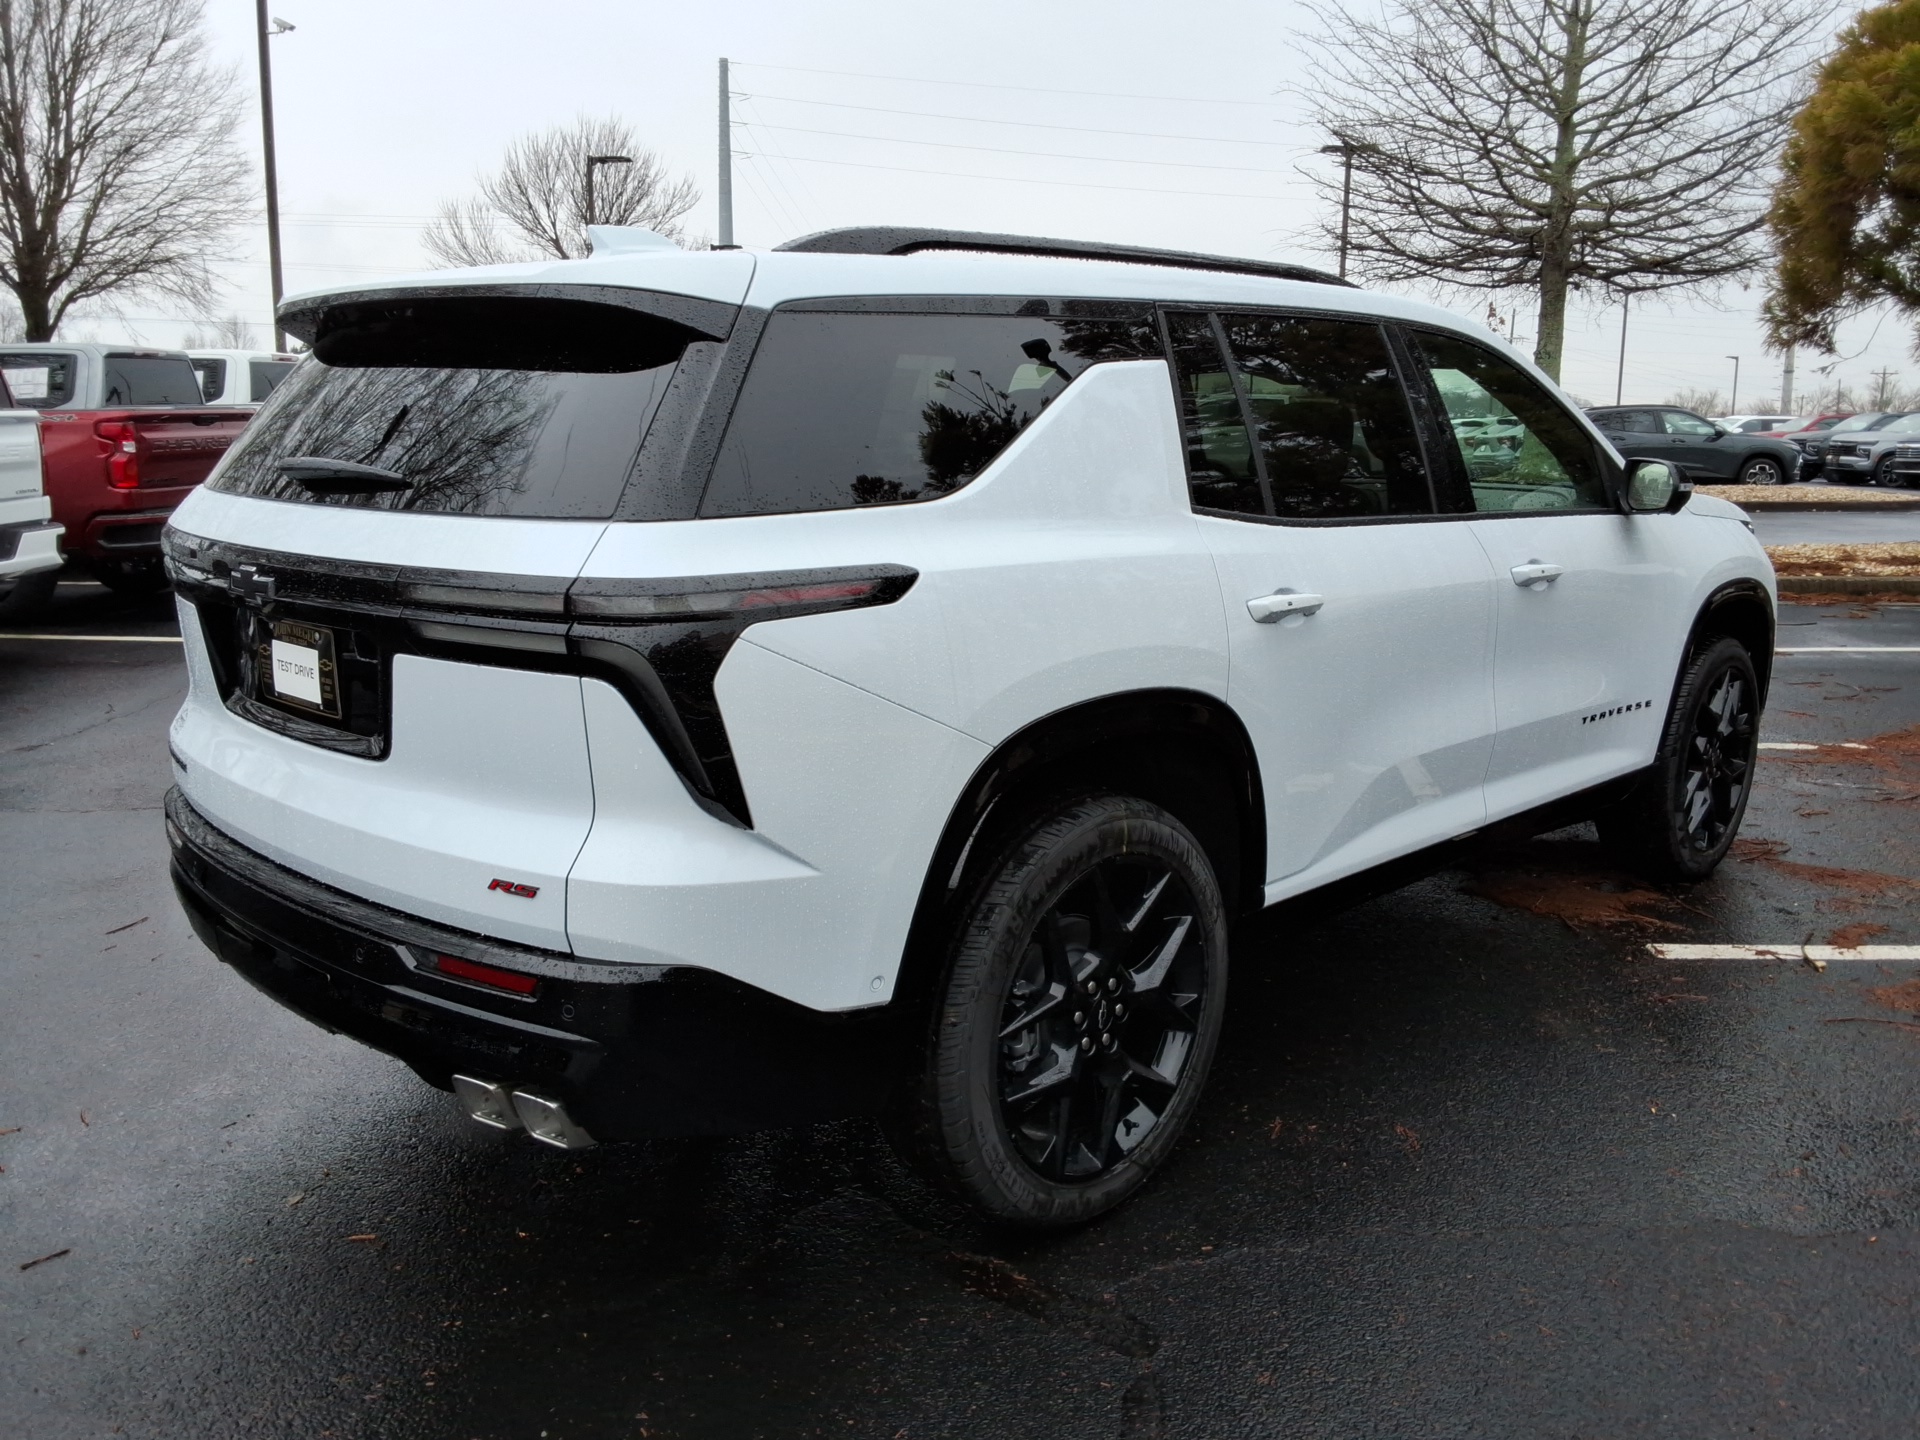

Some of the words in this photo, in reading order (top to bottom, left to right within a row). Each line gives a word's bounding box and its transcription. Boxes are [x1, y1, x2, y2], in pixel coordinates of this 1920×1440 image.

[152, 436, 235, 453] CHEVRO
[277, 659, 292, 674] TEST
[294, 664, 315, 680] DRIVE
[1582, 700, 1652, 725] TRAVERSE
[487, 878, 540, 899] RS
